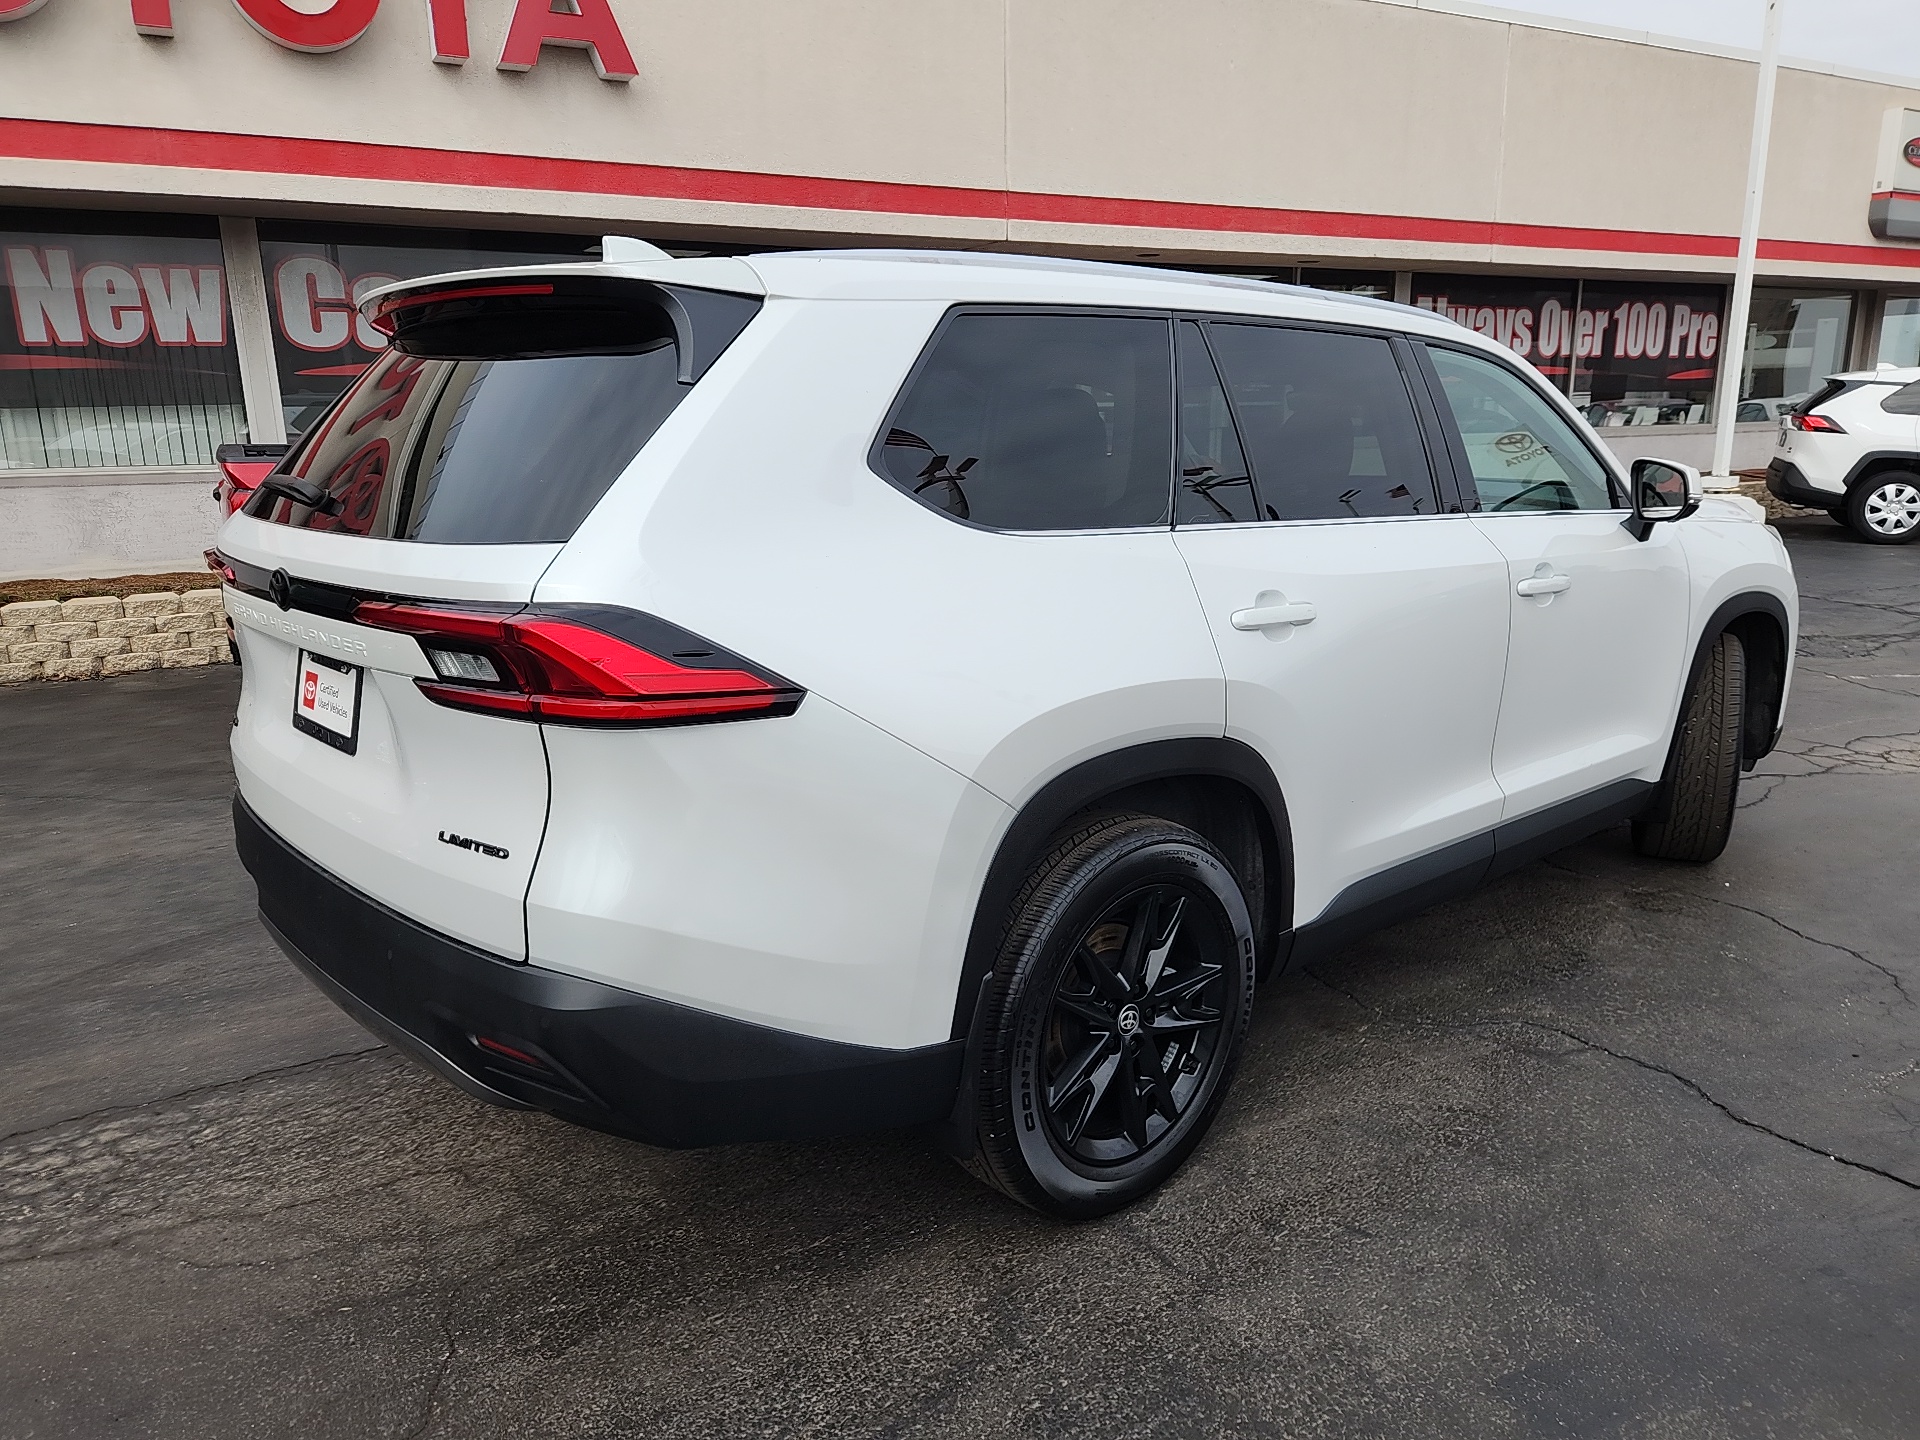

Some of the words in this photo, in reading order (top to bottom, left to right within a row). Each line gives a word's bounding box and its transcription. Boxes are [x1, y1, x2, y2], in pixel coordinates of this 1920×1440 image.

[5, 246, 227, 347] New
[1538, 299, 1609, 358] Over
[1614, 302, 1667, 359] 100
[1668, 304, 1718, 360] Pre
[233, 602, 268, 626] GRAND
[269, 616, 368, 657] HIGHLANDER
[318, 697, 330, 711] Used
[330, 702, 348, 718] Vehicles
[319, 682, 340, 698] Certified
[438, 830, 510, 859] LIMITED
